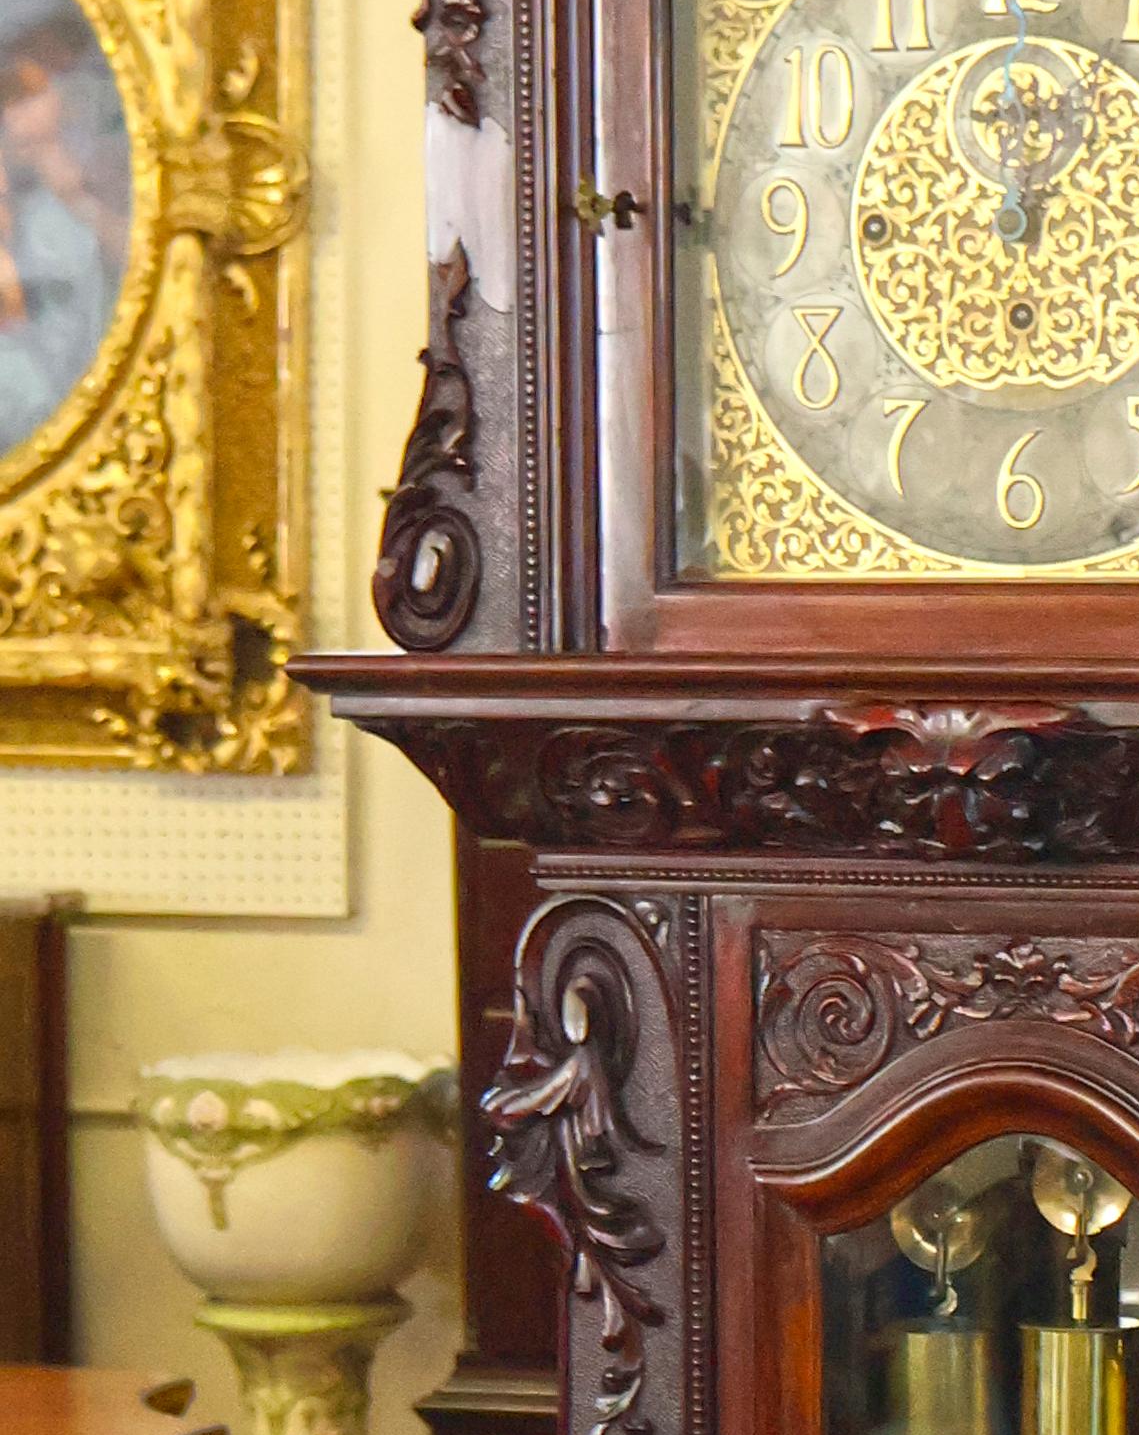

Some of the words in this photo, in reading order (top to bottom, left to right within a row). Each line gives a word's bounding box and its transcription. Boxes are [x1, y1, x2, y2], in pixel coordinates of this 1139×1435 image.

[778, 43, 854, 149] 10
[759, 176, 809, 278] 9
[790, 304, 842, 411] 8
[882, 396, 932, 499] 7
[995, 428, 1046, 530] 6
